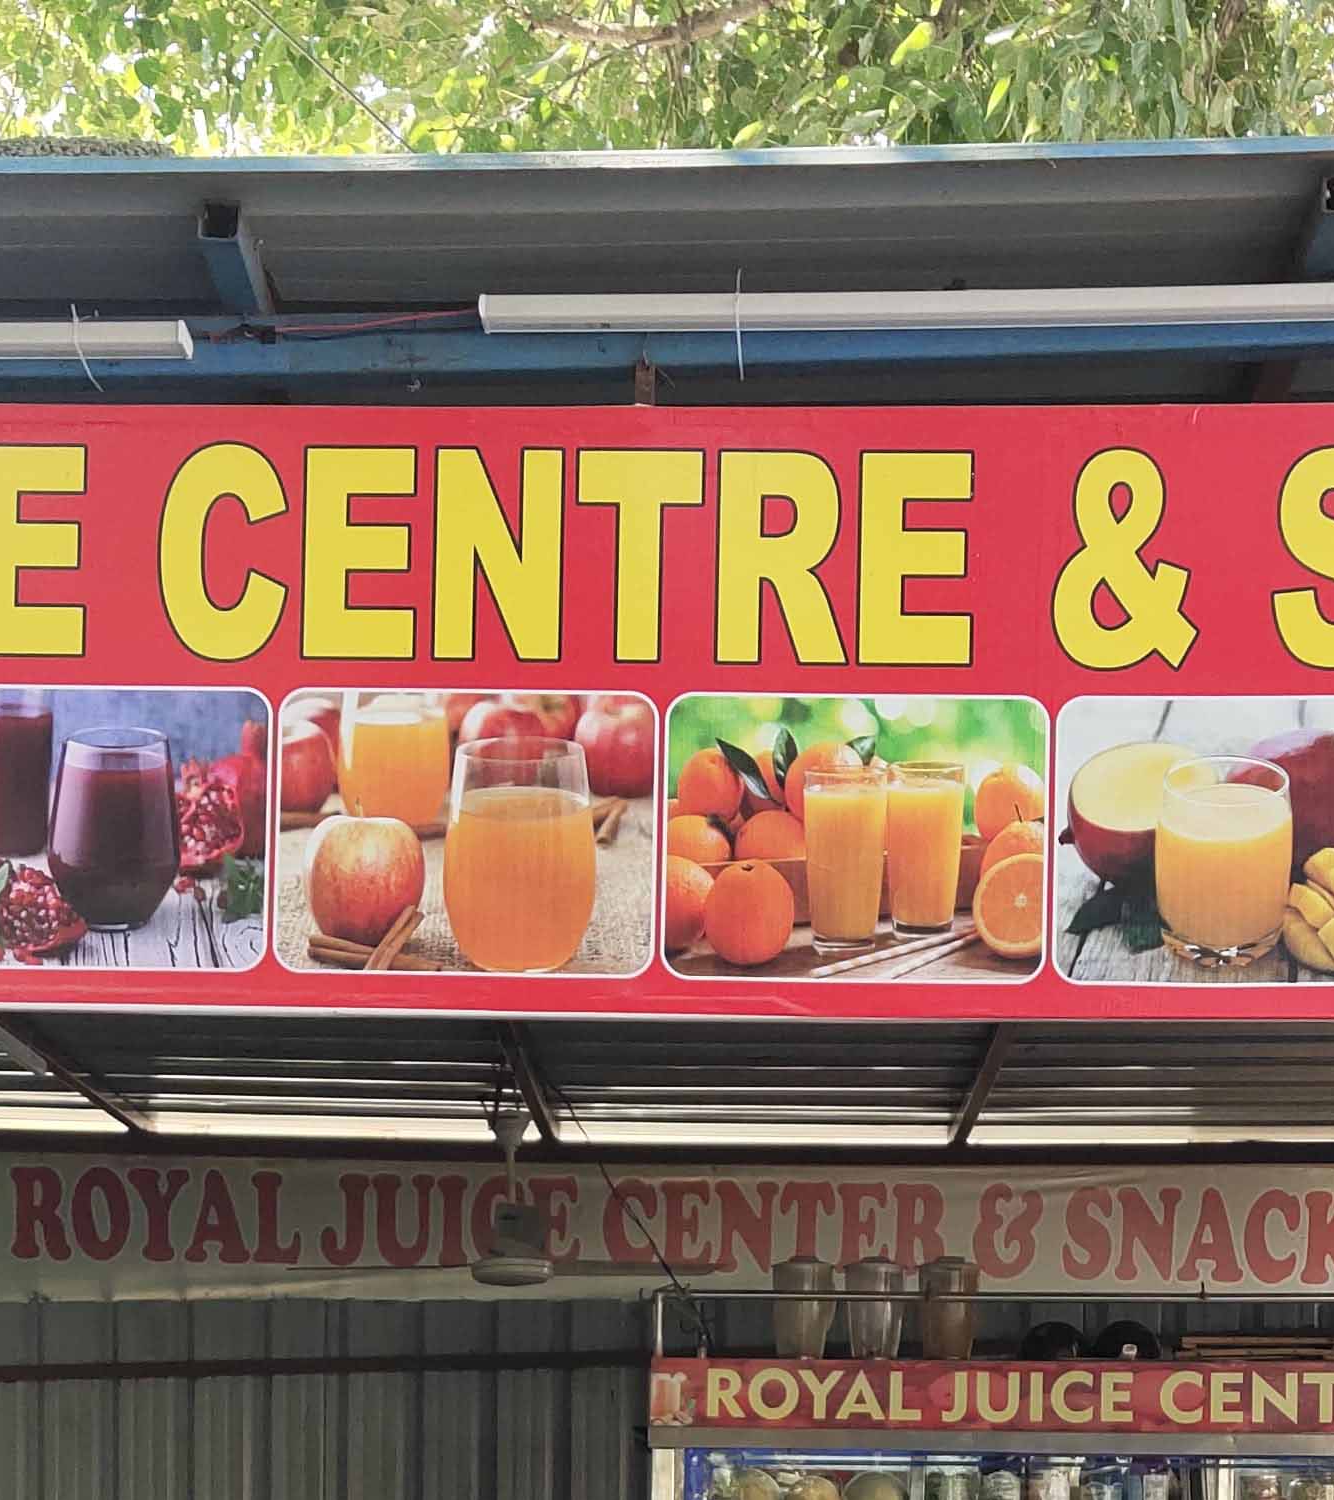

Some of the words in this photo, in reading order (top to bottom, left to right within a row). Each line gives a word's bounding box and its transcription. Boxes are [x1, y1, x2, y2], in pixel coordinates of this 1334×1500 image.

[158, 442, 972, 665] CENTRE
[1052, 448, 1198, 670] &
[9, 1166, 302, 1264] ROYAL
[601, 1177, 948, 1276] CENTER
[972, 1183, 1043, 1280] &
[705, 1368, 922, 1421] ROYAL
[940, 1369, 1137, 1424] JUICE
